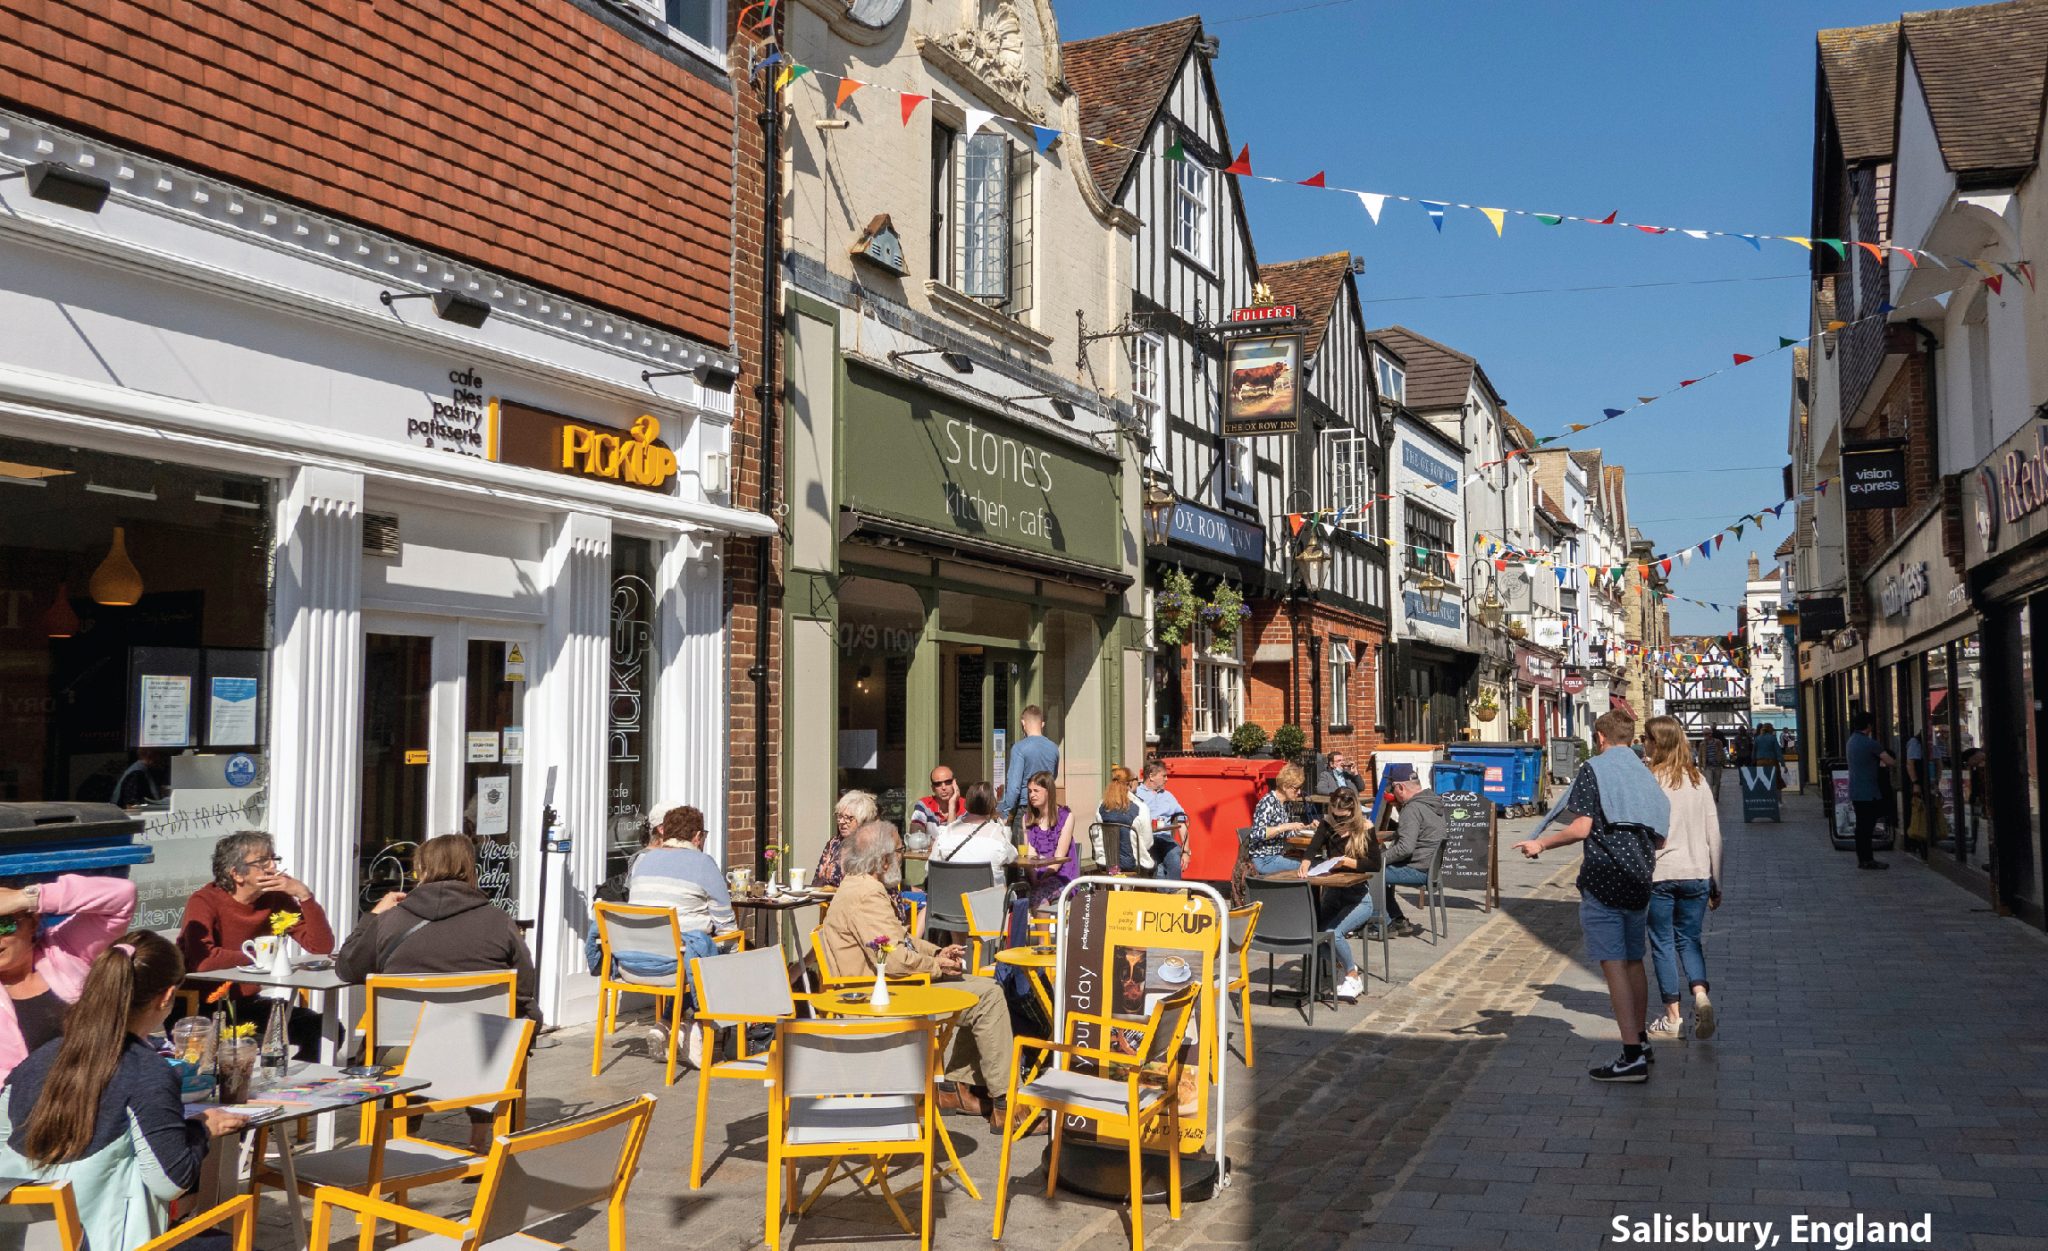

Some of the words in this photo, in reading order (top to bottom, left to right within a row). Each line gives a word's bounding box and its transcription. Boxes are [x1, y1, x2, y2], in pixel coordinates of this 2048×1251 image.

[449, 367, 483, 389] cafe
[453, 388, 482, 410] pies
[433, 402, 482, 430] pastry
[1225, 424, 1243, 432] THE
[1258, 422, 1278, 431] ROW
[1280, 421, 1297, 430] INN
[408, 418, 482, 446] patisserie
[562, 420, 677, 487] PICKUP
[946, 417, 1053, 492] stones
[1855, 467, 1893, 480] vision
[1850, 481, 1901, 495] express
[946, 481, 1008, 529] kitchen
[1019, 506, 1053, 540] cafe
[1175, 508, 1195, 534] OX
[1199, 515, 1227, 543] ROW
[1231, 526, 1251, 551] INN
[1741, 765, 1776, 792] W
[1143, 911, 1213, 934] PICKUP
[1070, 965, 1098, 1010] day
